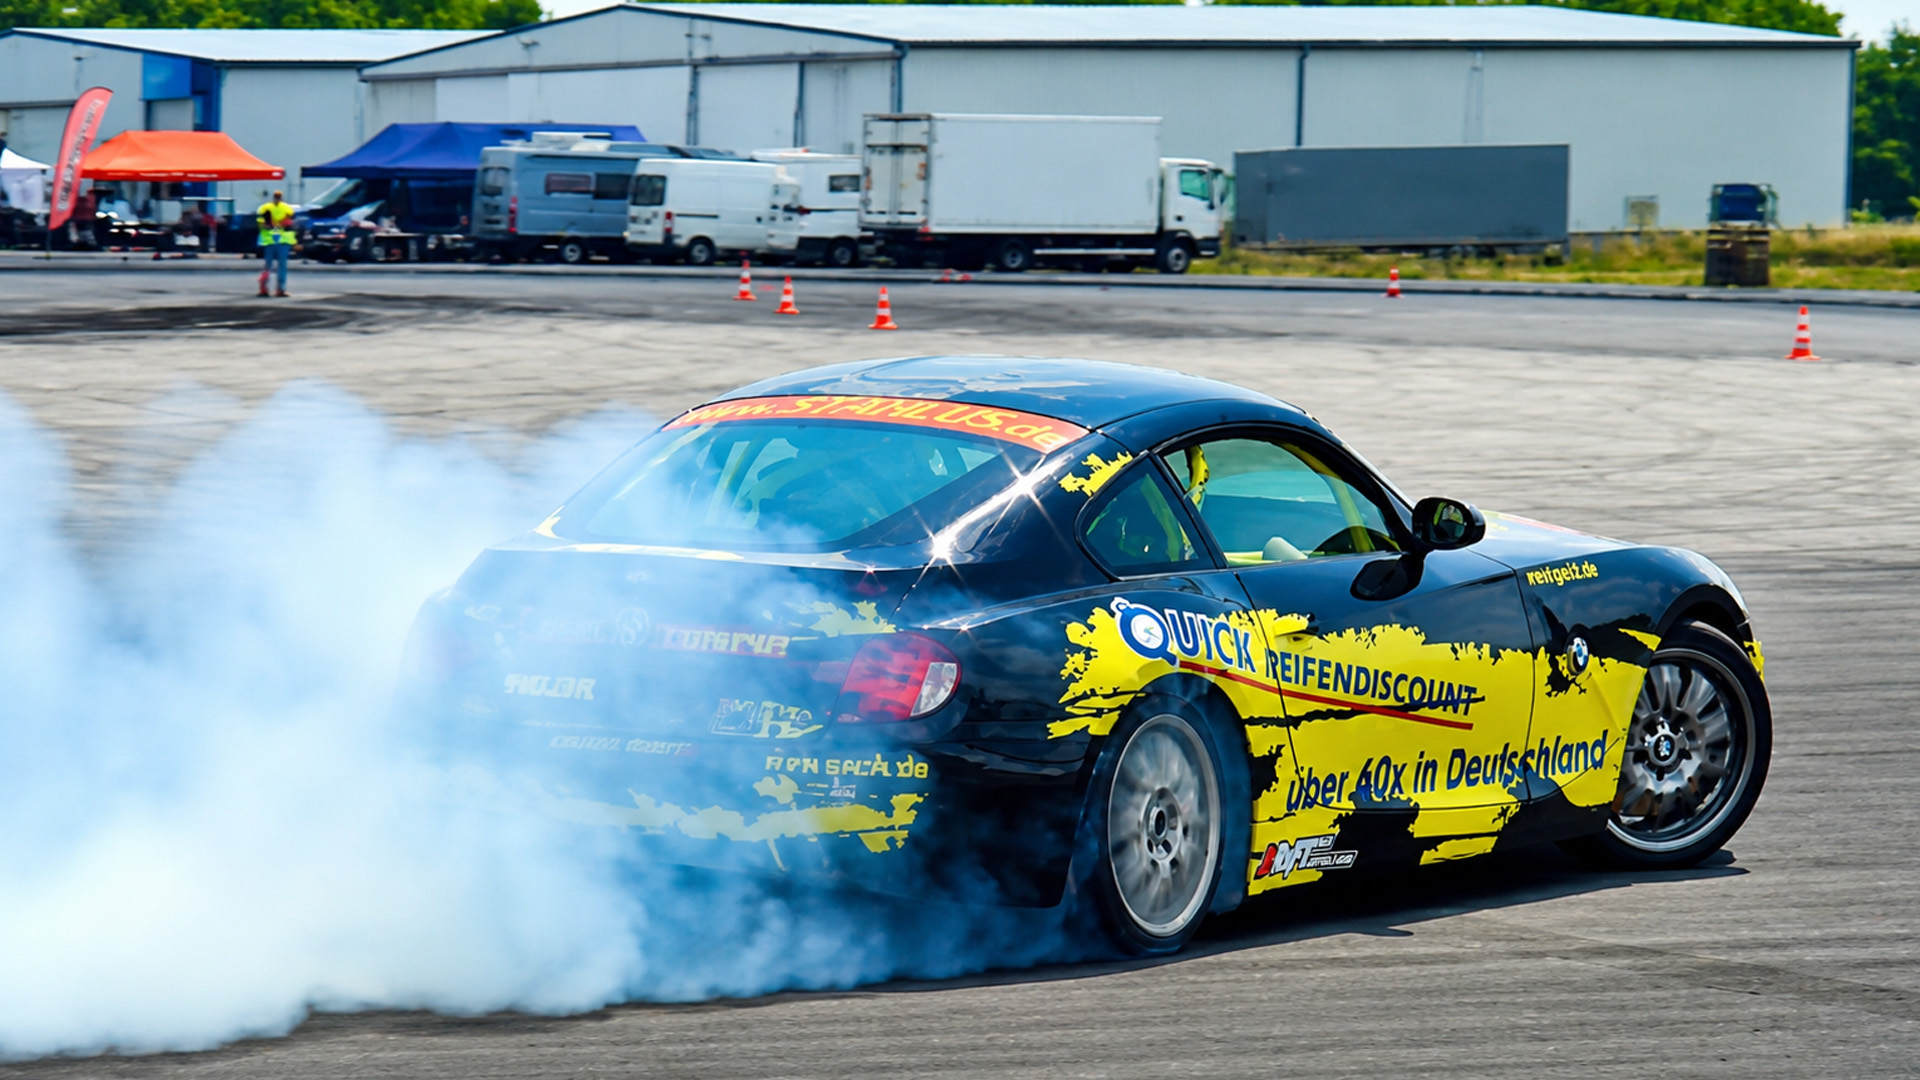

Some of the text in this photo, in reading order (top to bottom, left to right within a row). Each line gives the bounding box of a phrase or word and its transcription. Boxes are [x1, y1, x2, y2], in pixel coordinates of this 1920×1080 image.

[1110, 597, 1478, 716] QUICK REIFENDISCOUNT
[1286, 766, 1350, 812] über
[1413, 750, 1438, 794] in
[1446, 729, 1609, 789] Deutschland
